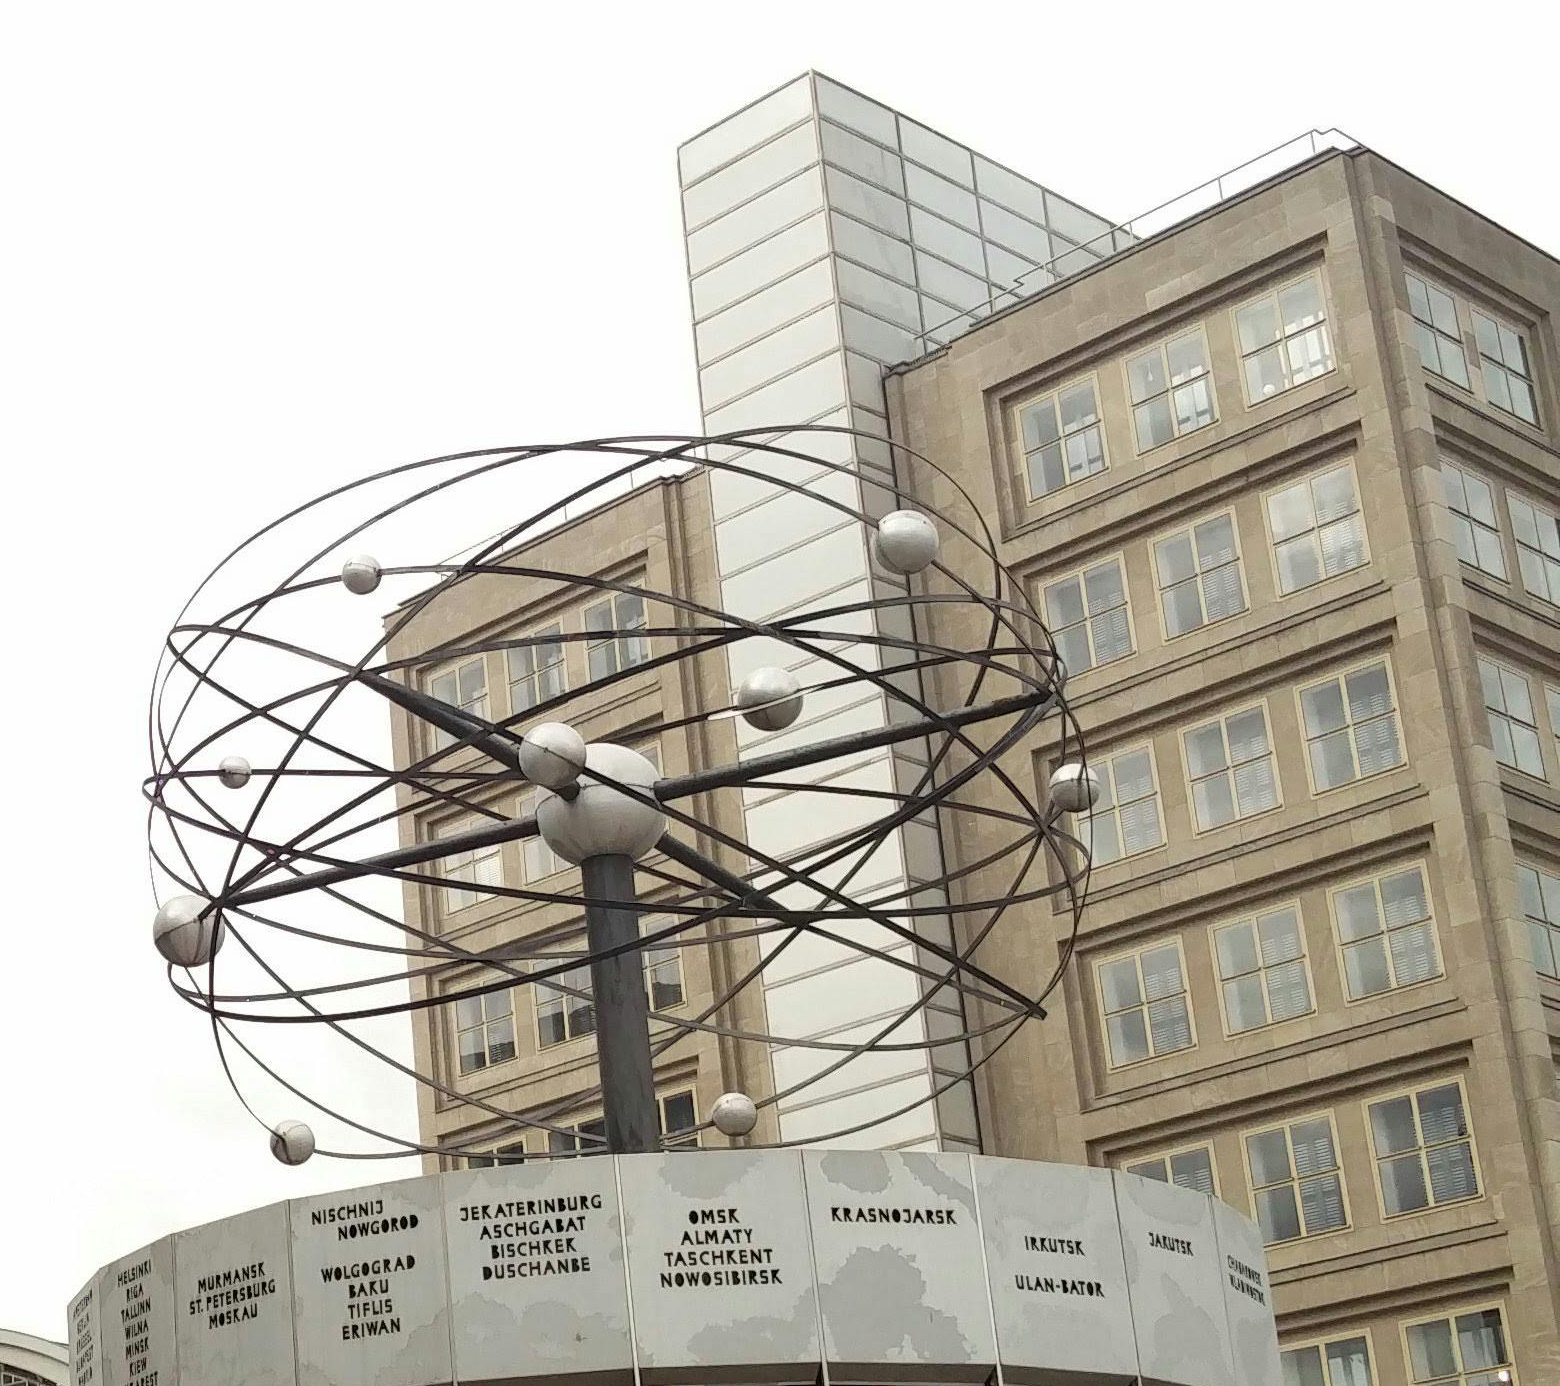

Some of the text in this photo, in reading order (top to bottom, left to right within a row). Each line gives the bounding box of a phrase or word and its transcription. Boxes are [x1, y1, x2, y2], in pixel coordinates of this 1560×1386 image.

[311, 1200, 384, 1226] NISCHNIJ
[459, 1194, 603, 1222] JEKATERINBURG
[689, 1208, 739, 1225] OMSK
[830, 1207, 958, 1225] KRASNOJARSK
[338, 1214, 419, 1241] NOWGOROD
[479, 1216, 586, 1241] ASCHGABAT
[680, 1229, 753, 1246] ALMATY
[491, 1237, 577, 1260] BISCHKEK
[1024, 1235, 1087, 1258] IRKUTSK
[1148, 1232, 1194, 1256] JAKUTSK
[321, 1255, 416, 1283] WOLGOGRAD
[482, 1257, 591, 1281] DUSCHANBE
[664, 1249, 773, 1268] TASCHKENT
[117, 1259, 151, 1287] HELSINKI
[198, 1261, 266, 1294] MURMANSK
[660, 1269, 783, 1288] NOWOSIBIRSK
[126, 1283, 144, 1303] RIGA
[189, 1279, 276, 1316] ST. PETERSBURG
[348, 1279, 389, 1299] BAKU
[1015, 1274, 1105, 1298] ULAN-BATOR
[121, 1296, 151, 1324] TALLINN
[208, 1303, 258, 1330] MOSKAU
[348, 1298, 393, 1320] TIFLIS
[124, 1318, 149, 1340] WILNA
[342, 1318, 401, 1341] ERIWAN
[126, 1337, 149, 1359] MINSK
[129, 1357, 147, 1378] KIEW
